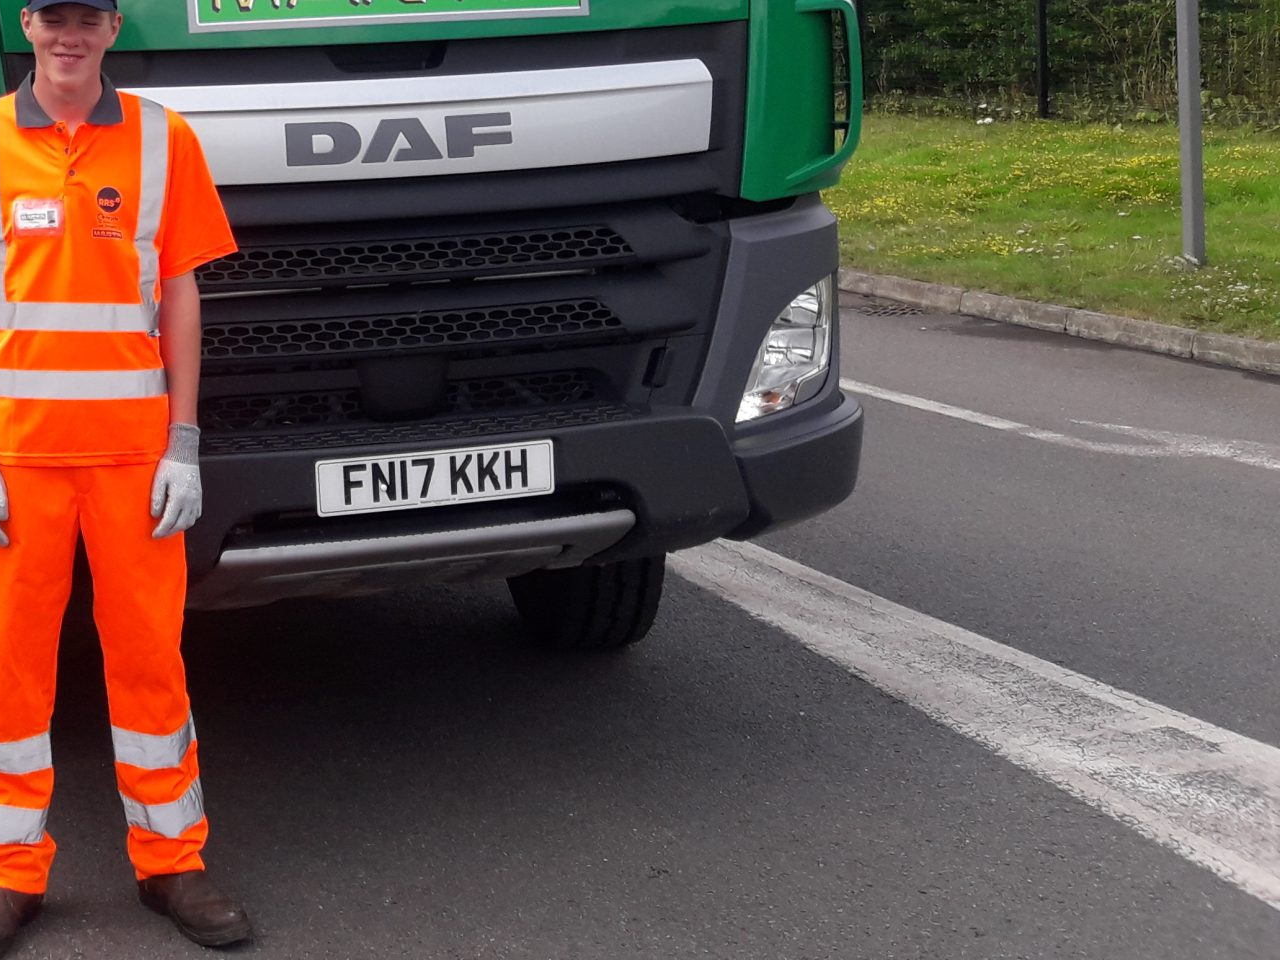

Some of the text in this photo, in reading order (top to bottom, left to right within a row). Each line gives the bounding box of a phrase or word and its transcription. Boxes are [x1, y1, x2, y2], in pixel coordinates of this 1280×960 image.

[283, 111, 513, 167] DAF
[342, 448, 529, 506] FN17 KKH
